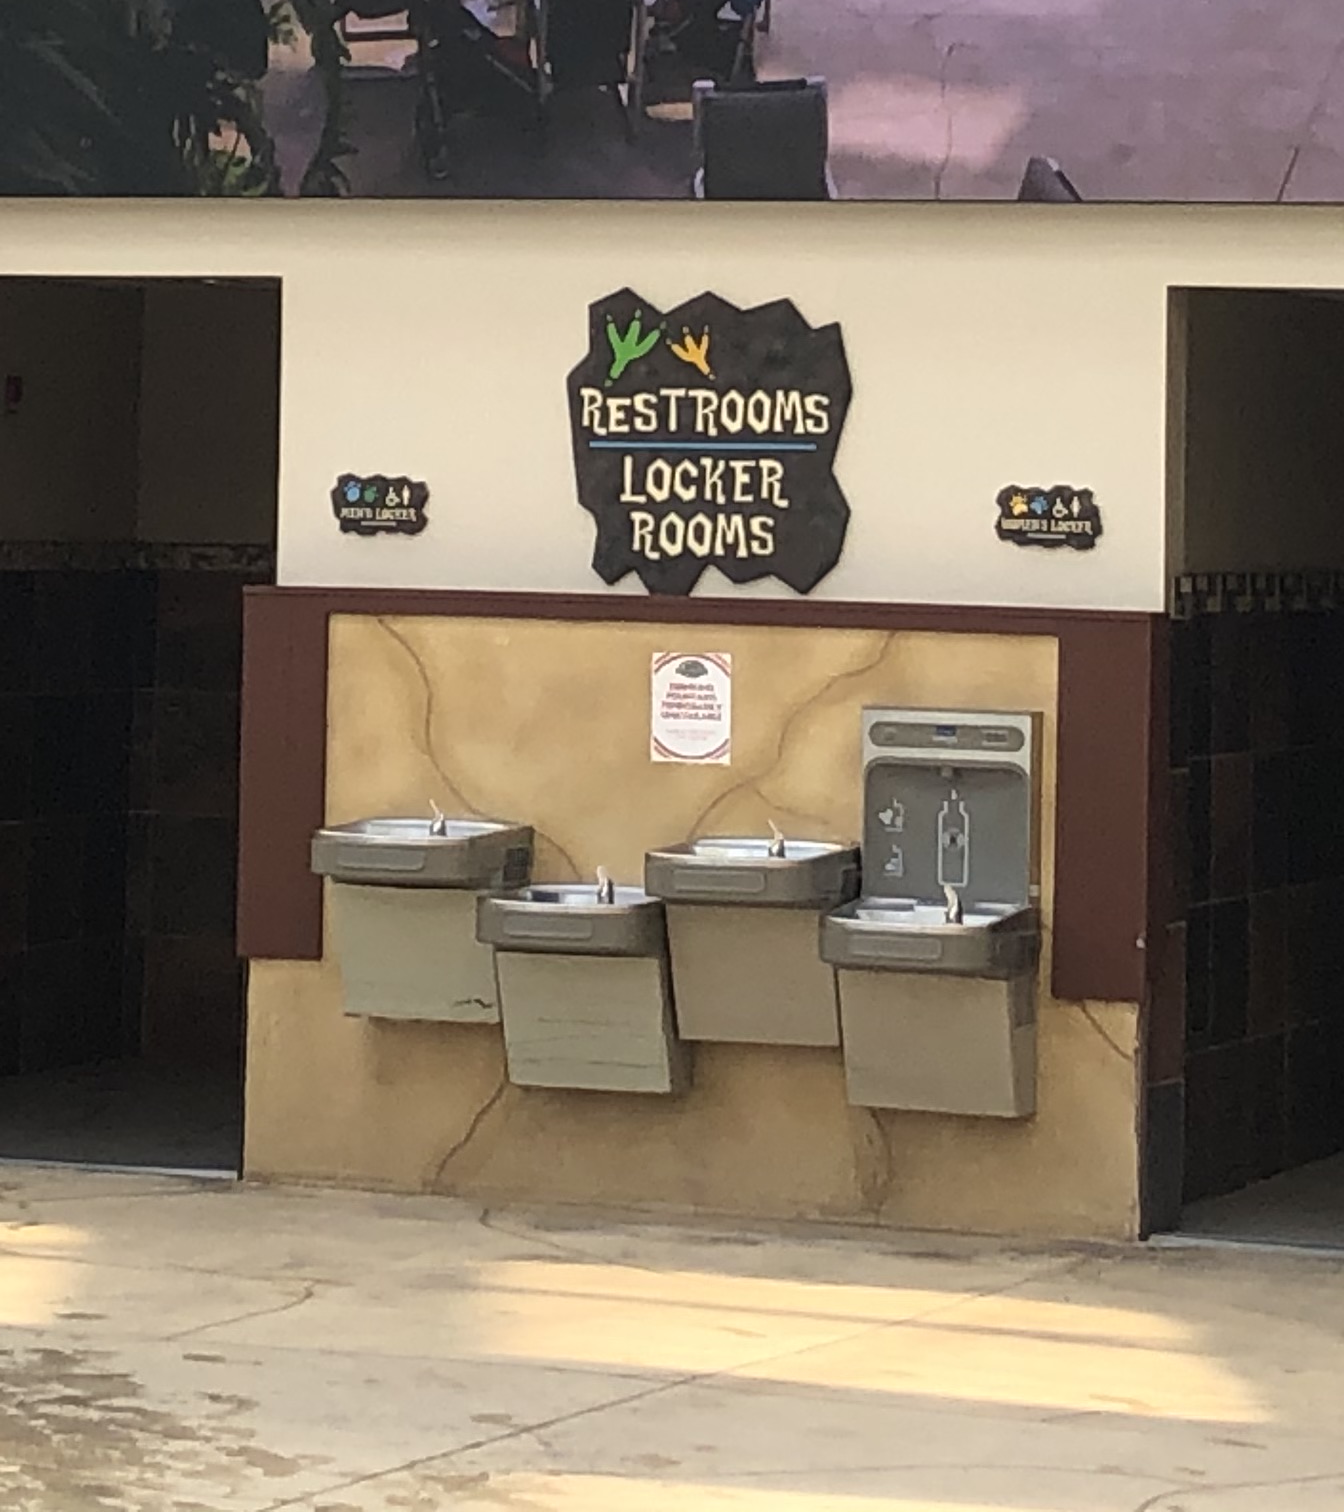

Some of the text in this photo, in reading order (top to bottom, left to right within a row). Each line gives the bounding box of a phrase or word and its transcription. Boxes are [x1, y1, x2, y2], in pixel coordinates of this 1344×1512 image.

[579, 387, 830, 437] RESTROOMS
[619, 455, 789, 509] LOCKER
[630, 511, 775, 560] ROOMS
